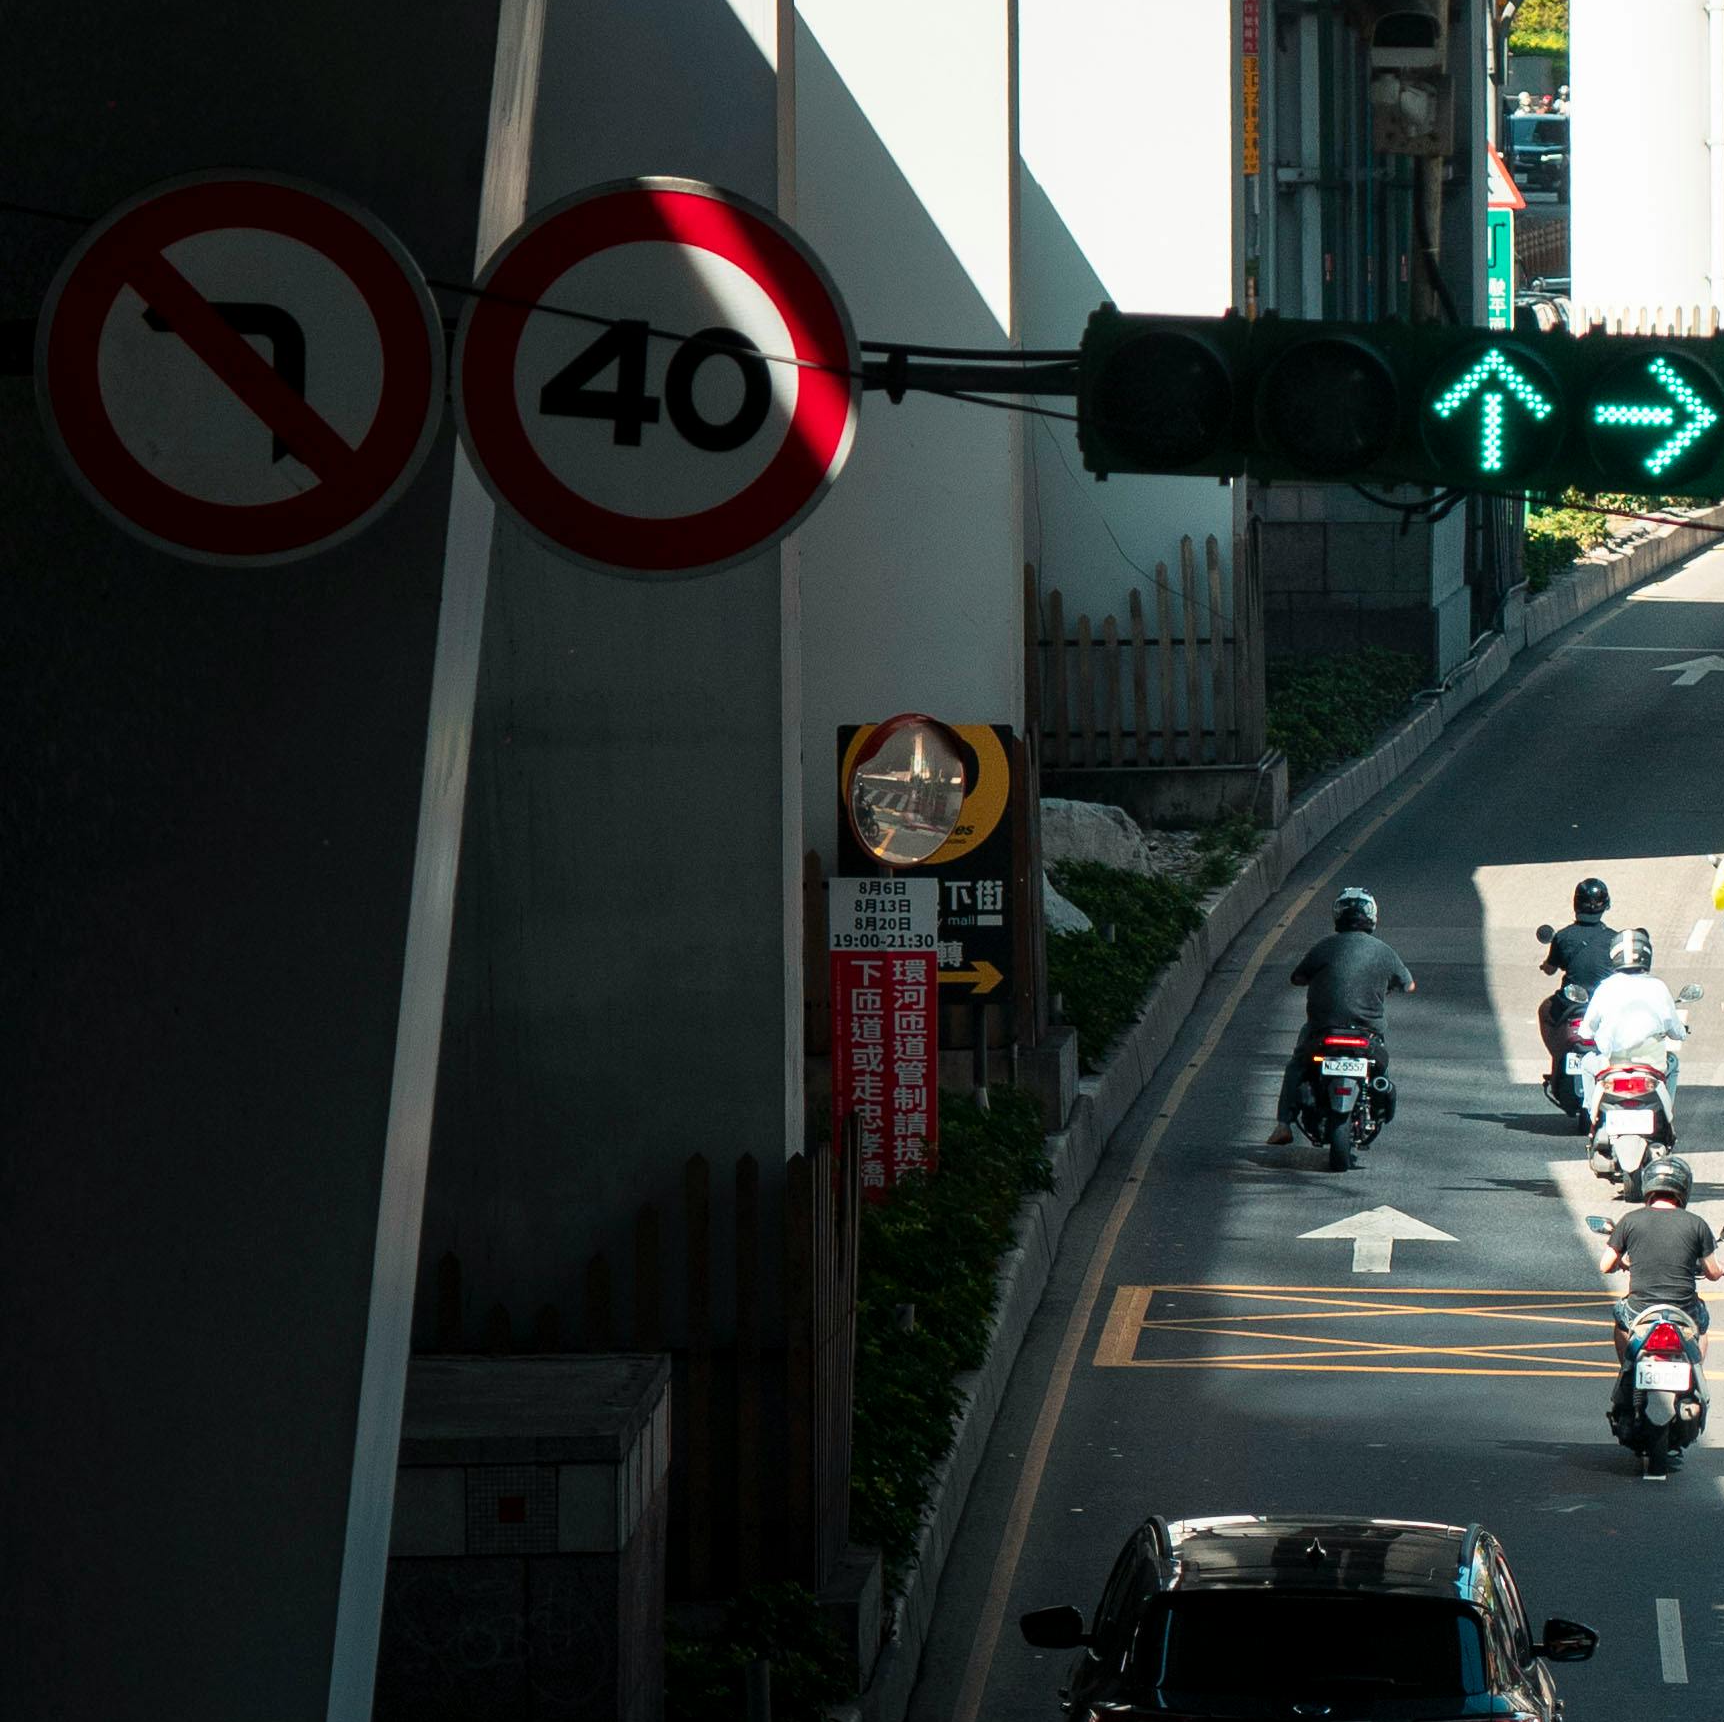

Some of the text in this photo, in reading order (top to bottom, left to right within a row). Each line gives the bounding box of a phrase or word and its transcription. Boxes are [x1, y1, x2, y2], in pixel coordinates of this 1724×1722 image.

[540, 319, 772, 452] 40
[858, 881, 907, 895] 8月6日
[944, 880, 1004, 911] 下街
[854, 899, 911, 913] 8月13日
[854, 917, 911, 931] 8月20日
[834, 934, 934, 948] 19:00-21:30
